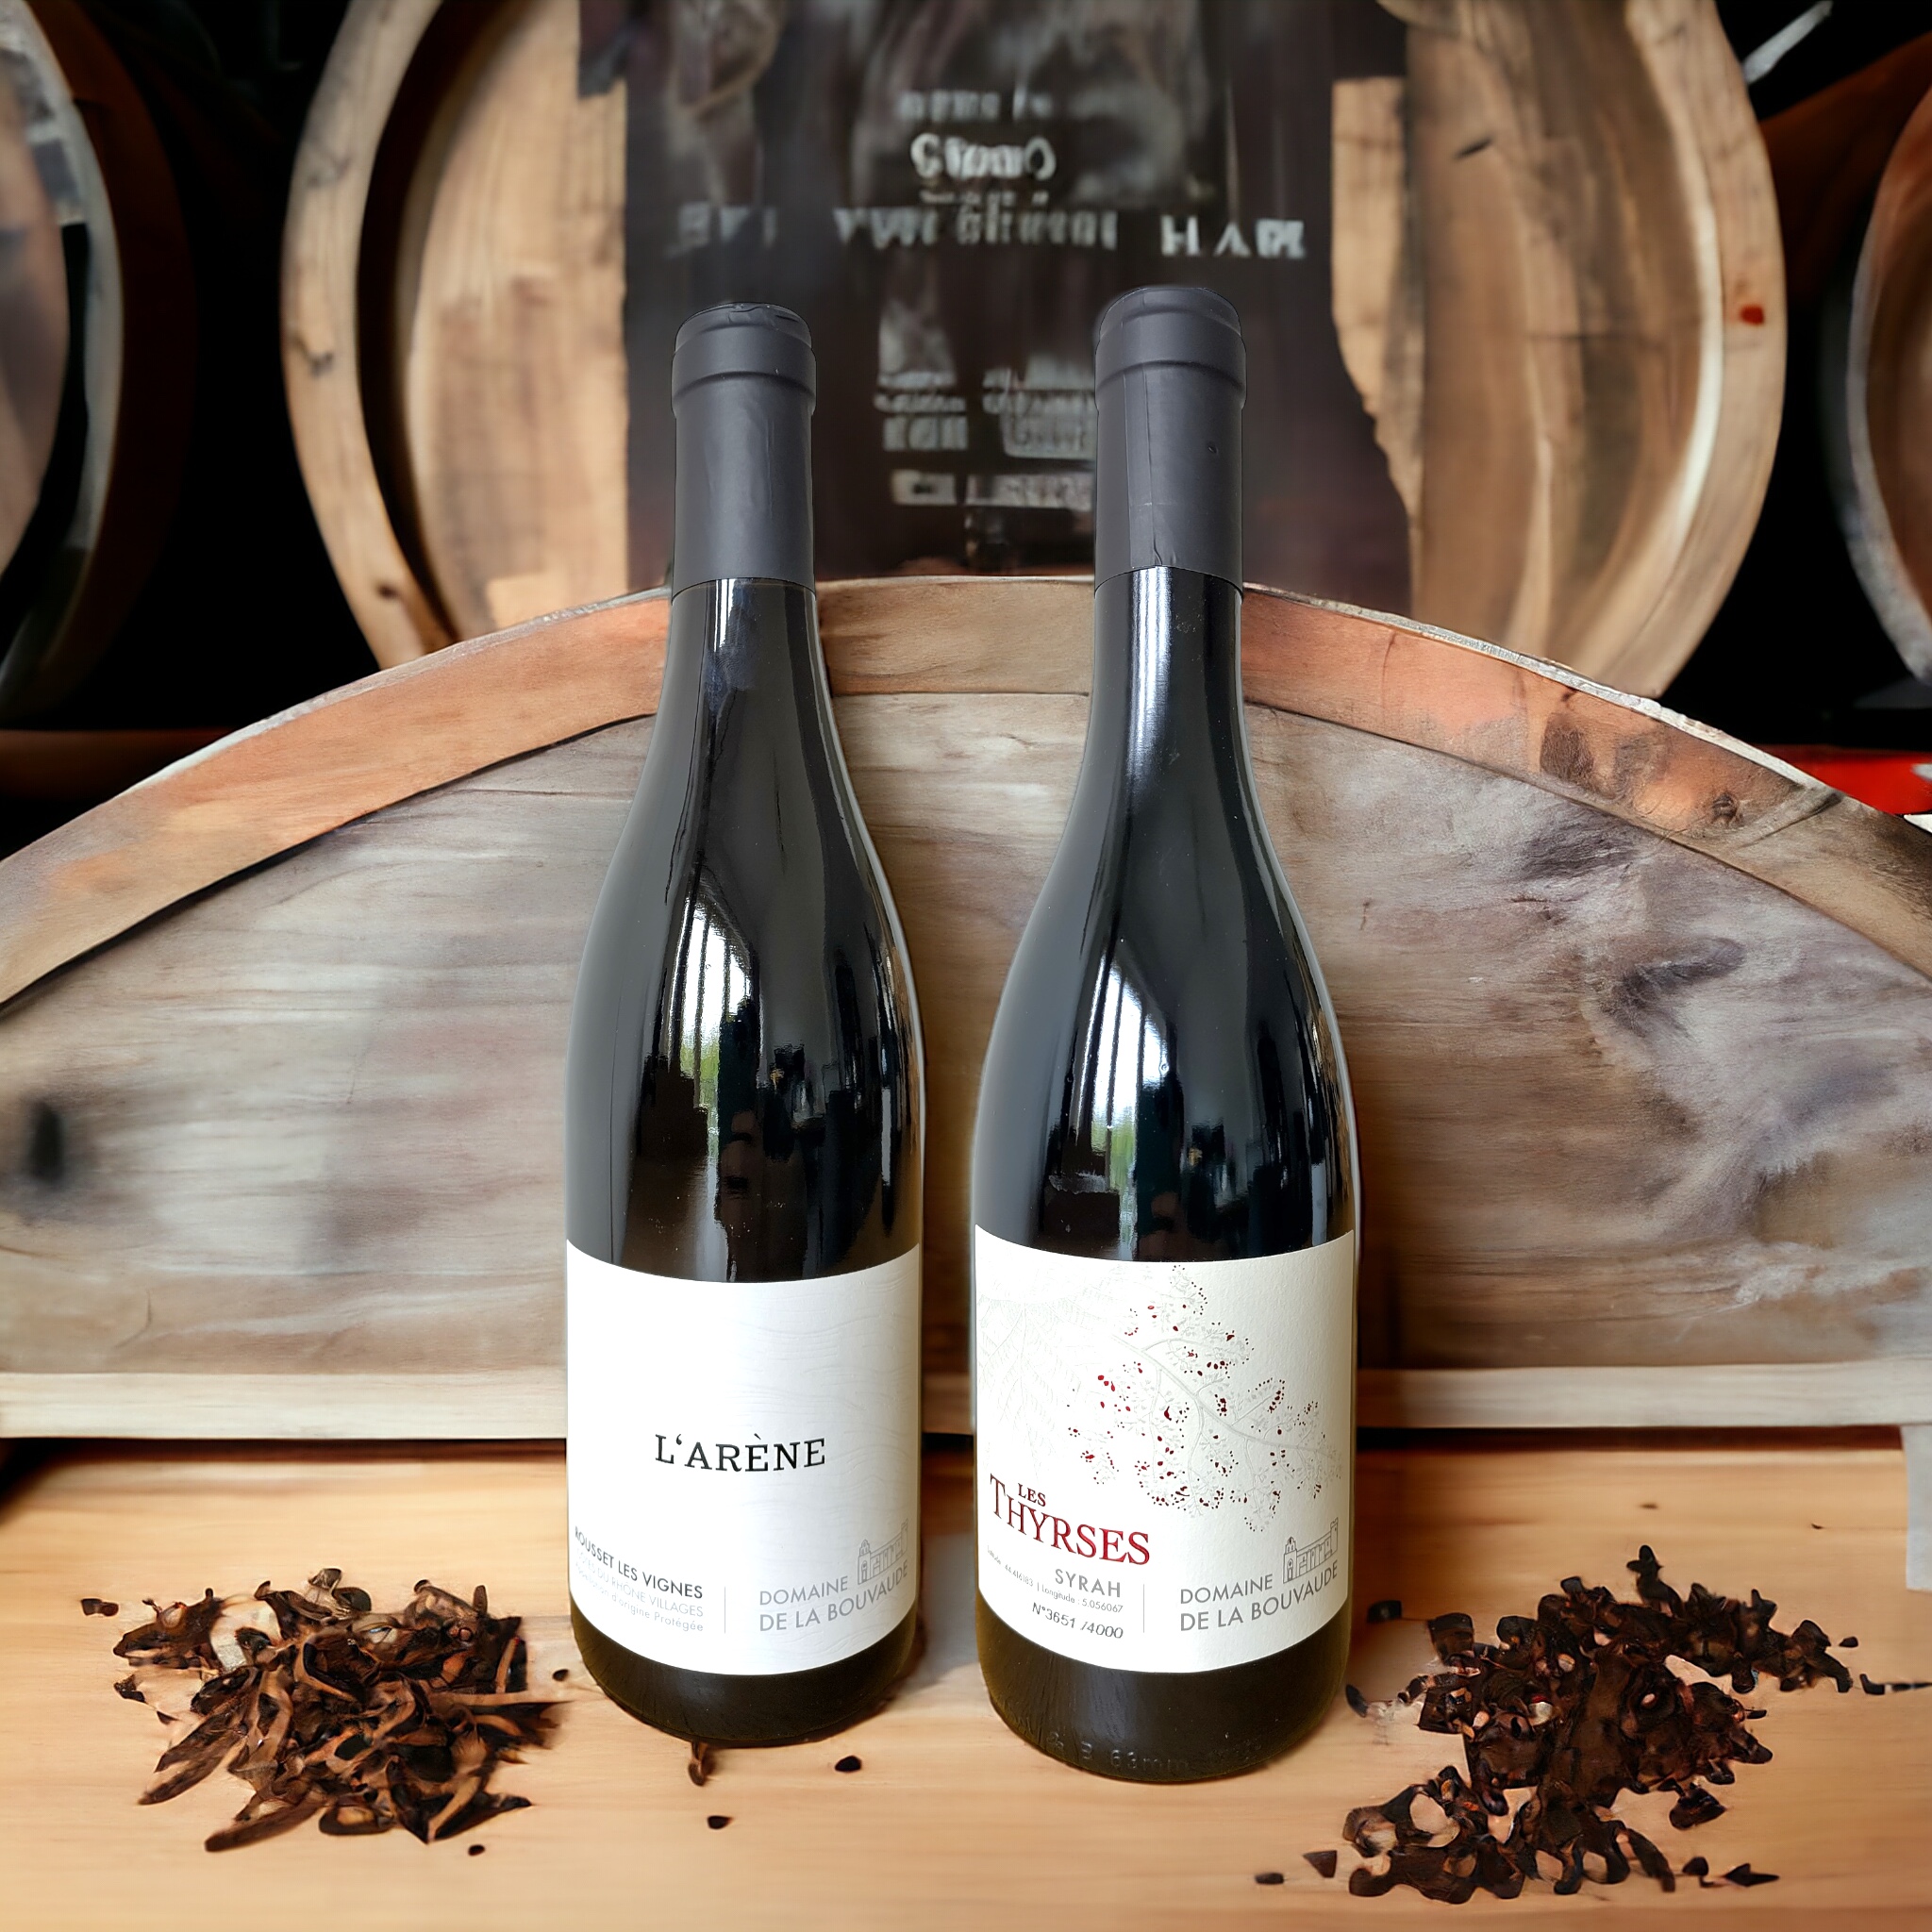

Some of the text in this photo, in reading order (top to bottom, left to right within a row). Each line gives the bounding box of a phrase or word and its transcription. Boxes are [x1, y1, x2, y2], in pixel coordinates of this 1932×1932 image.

[1018, 1483, 1046, 1507] LES
[990, 1473, 1150, 1565] THYRSES
[575, 1525, 614, 1568] ROUSSET
[618, 1560, 638, 1581] LES
[642, 1572, 703, 1599] VIGNES
[760, 1575, 848, 1605] DOMAINE
[760, 1559, 908, 1632] DE LA BOUVAUDE
[1055, 1569, 1120, 1597] SYRAH
[1180, 1574, 1273, 1604] DOMAINE
[1180, 1559, 1338, 1631] DE LA BOUVAUDE
[649, 1594, 703, 1618] VILLAGES
[1032, 1602, 1124, 1639] N°3651 /4000
[1082, 1598, 1124, 1613] 5.056067
[655, 1611, 703, 1632] Protégée
